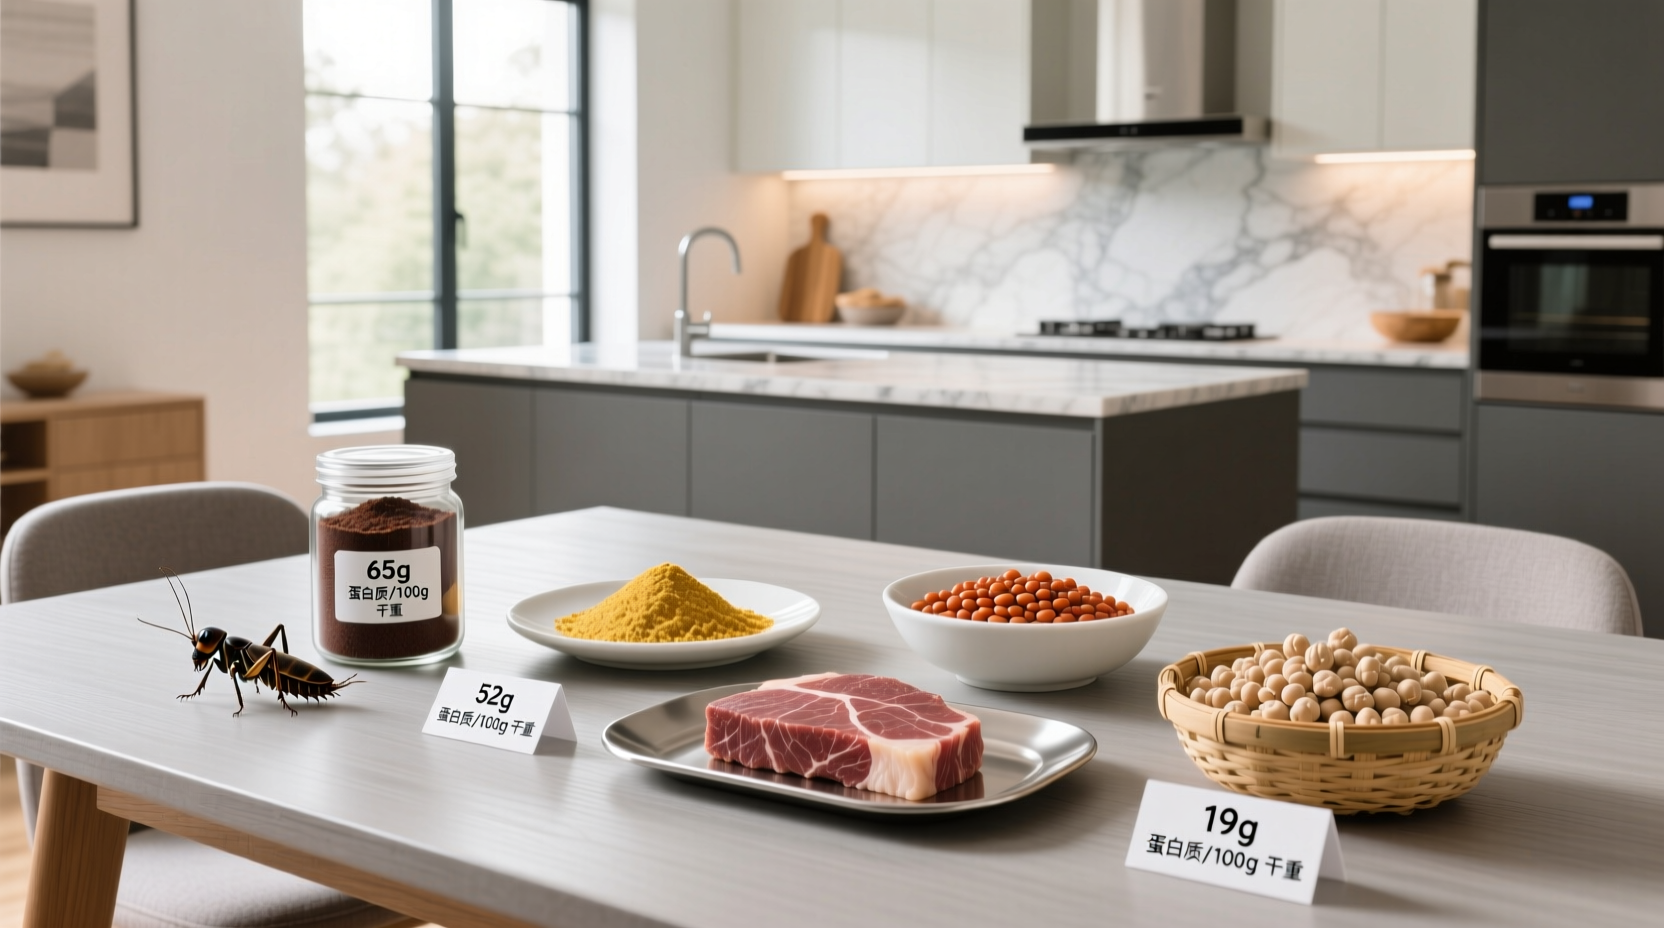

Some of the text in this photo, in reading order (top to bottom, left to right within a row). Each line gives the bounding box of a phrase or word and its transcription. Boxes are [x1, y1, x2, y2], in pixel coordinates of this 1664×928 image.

[367, 560, 410, 584] 65g
[348, 585, 429, 601] 蛋白质/100g
[376, 603, 403, 618] 干重
[475, 682, 515, 714] 52g
[437, 706, 536, 737] 蛋白质/100g 干重
[1204, 804, 1259, 847] 19g
[1146, 833, 1304, 882] 蛋白质/100g 干重
